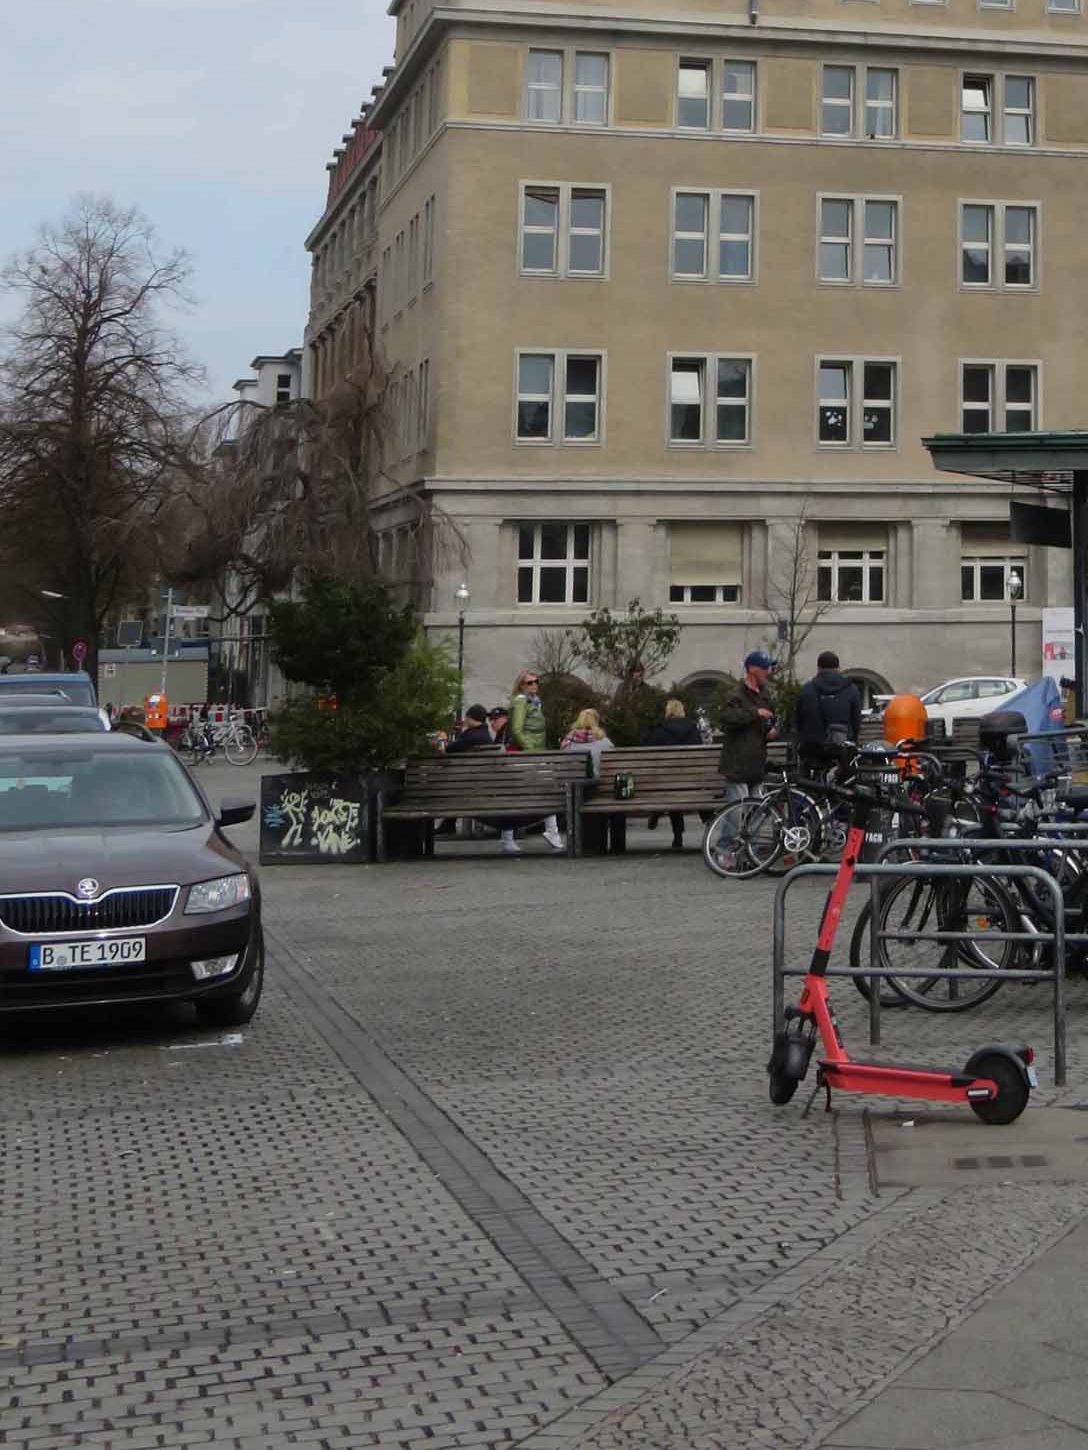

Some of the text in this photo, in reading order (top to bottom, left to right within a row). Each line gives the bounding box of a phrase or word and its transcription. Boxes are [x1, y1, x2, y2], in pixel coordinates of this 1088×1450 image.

[42, 941, 143, 965] B TE 1909
